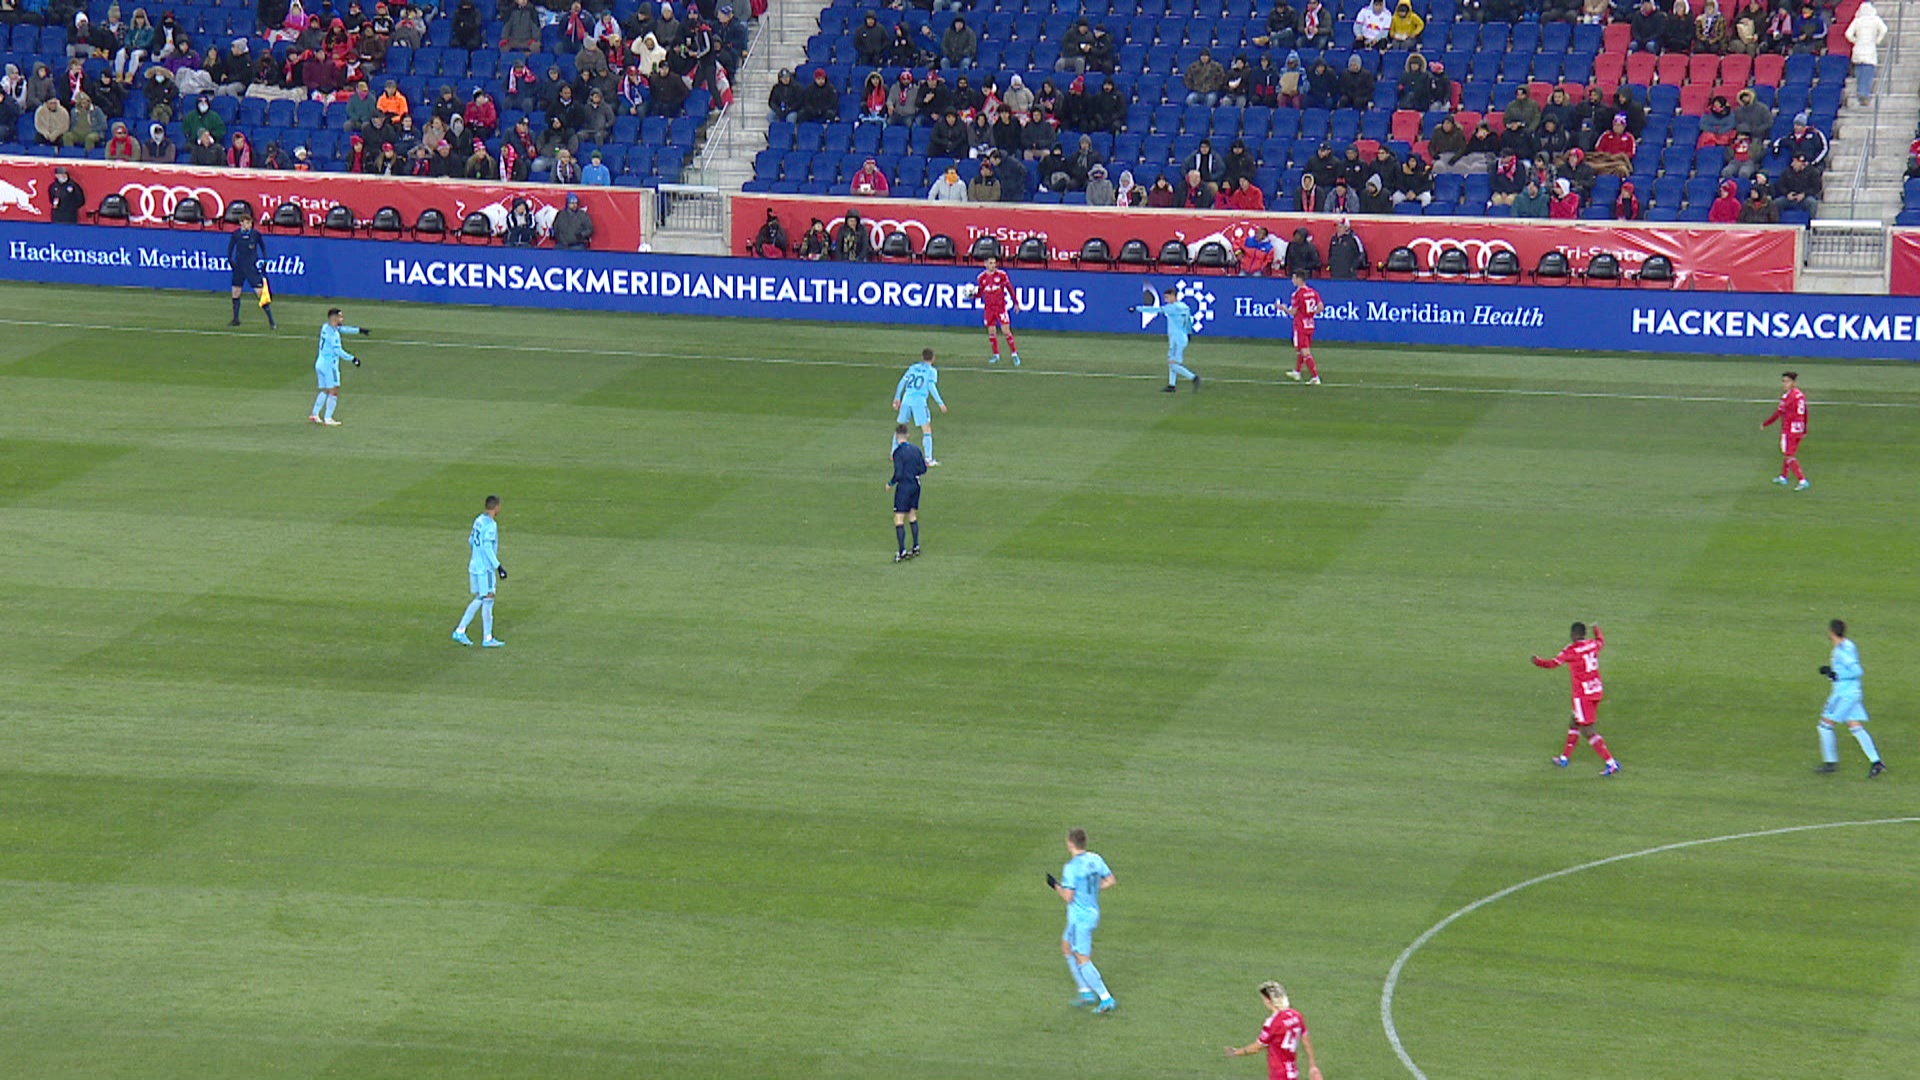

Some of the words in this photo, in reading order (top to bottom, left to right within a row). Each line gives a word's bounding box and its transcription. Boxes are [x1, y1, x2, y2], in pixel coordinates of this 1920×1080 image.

[9, 241, 132, 266] Hackensack
[138, 247, 233, 272] Meridian
[256, 254, 306, 276] ealth
[1367, 301, 1465, 325] Meridian
[1472, 305, 1544, 328] Health
[1632, 308, 1920, 342] HACKENSACKME
[906, 373, 925, 391] 20
